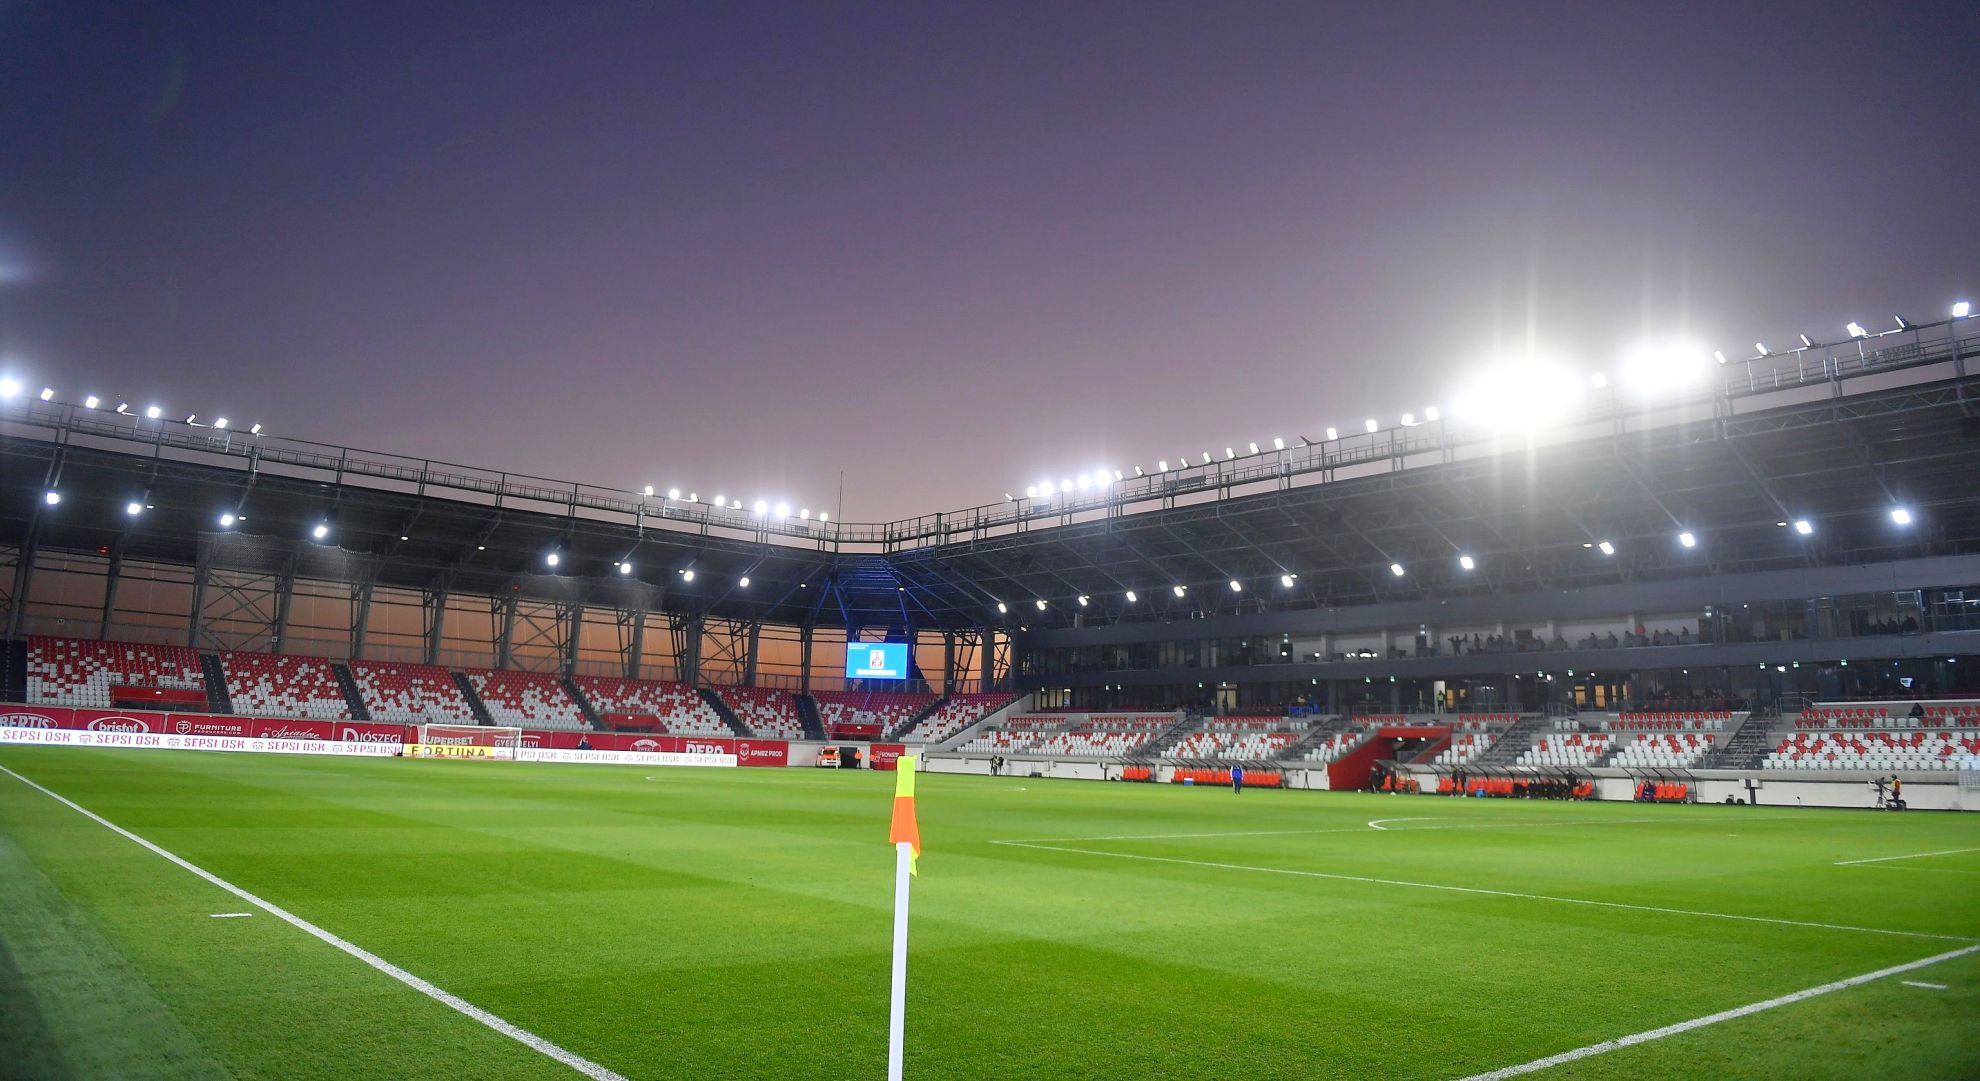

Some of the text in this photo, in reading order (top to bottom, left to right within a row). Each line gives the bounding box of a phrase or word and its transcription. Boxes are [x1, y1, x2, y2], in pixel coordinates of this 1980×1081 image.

[194, 724, 242, 732] FURNITURE
[3, 729, 71, 742] SEPSI OSK
[97, 734, 160, 746] SEPSI OSK
[343, 727, 401, 743] DIÓSZEGI
[420, 735, 474, 746] SUPERBET
[184, 738, 245, 749] SEPSI OSK
[268, 741, 325, 752] SEPSI OSK
[347, 744, 377, 754] SEPSI
[411, 746, 485, 757] FORTUNA
